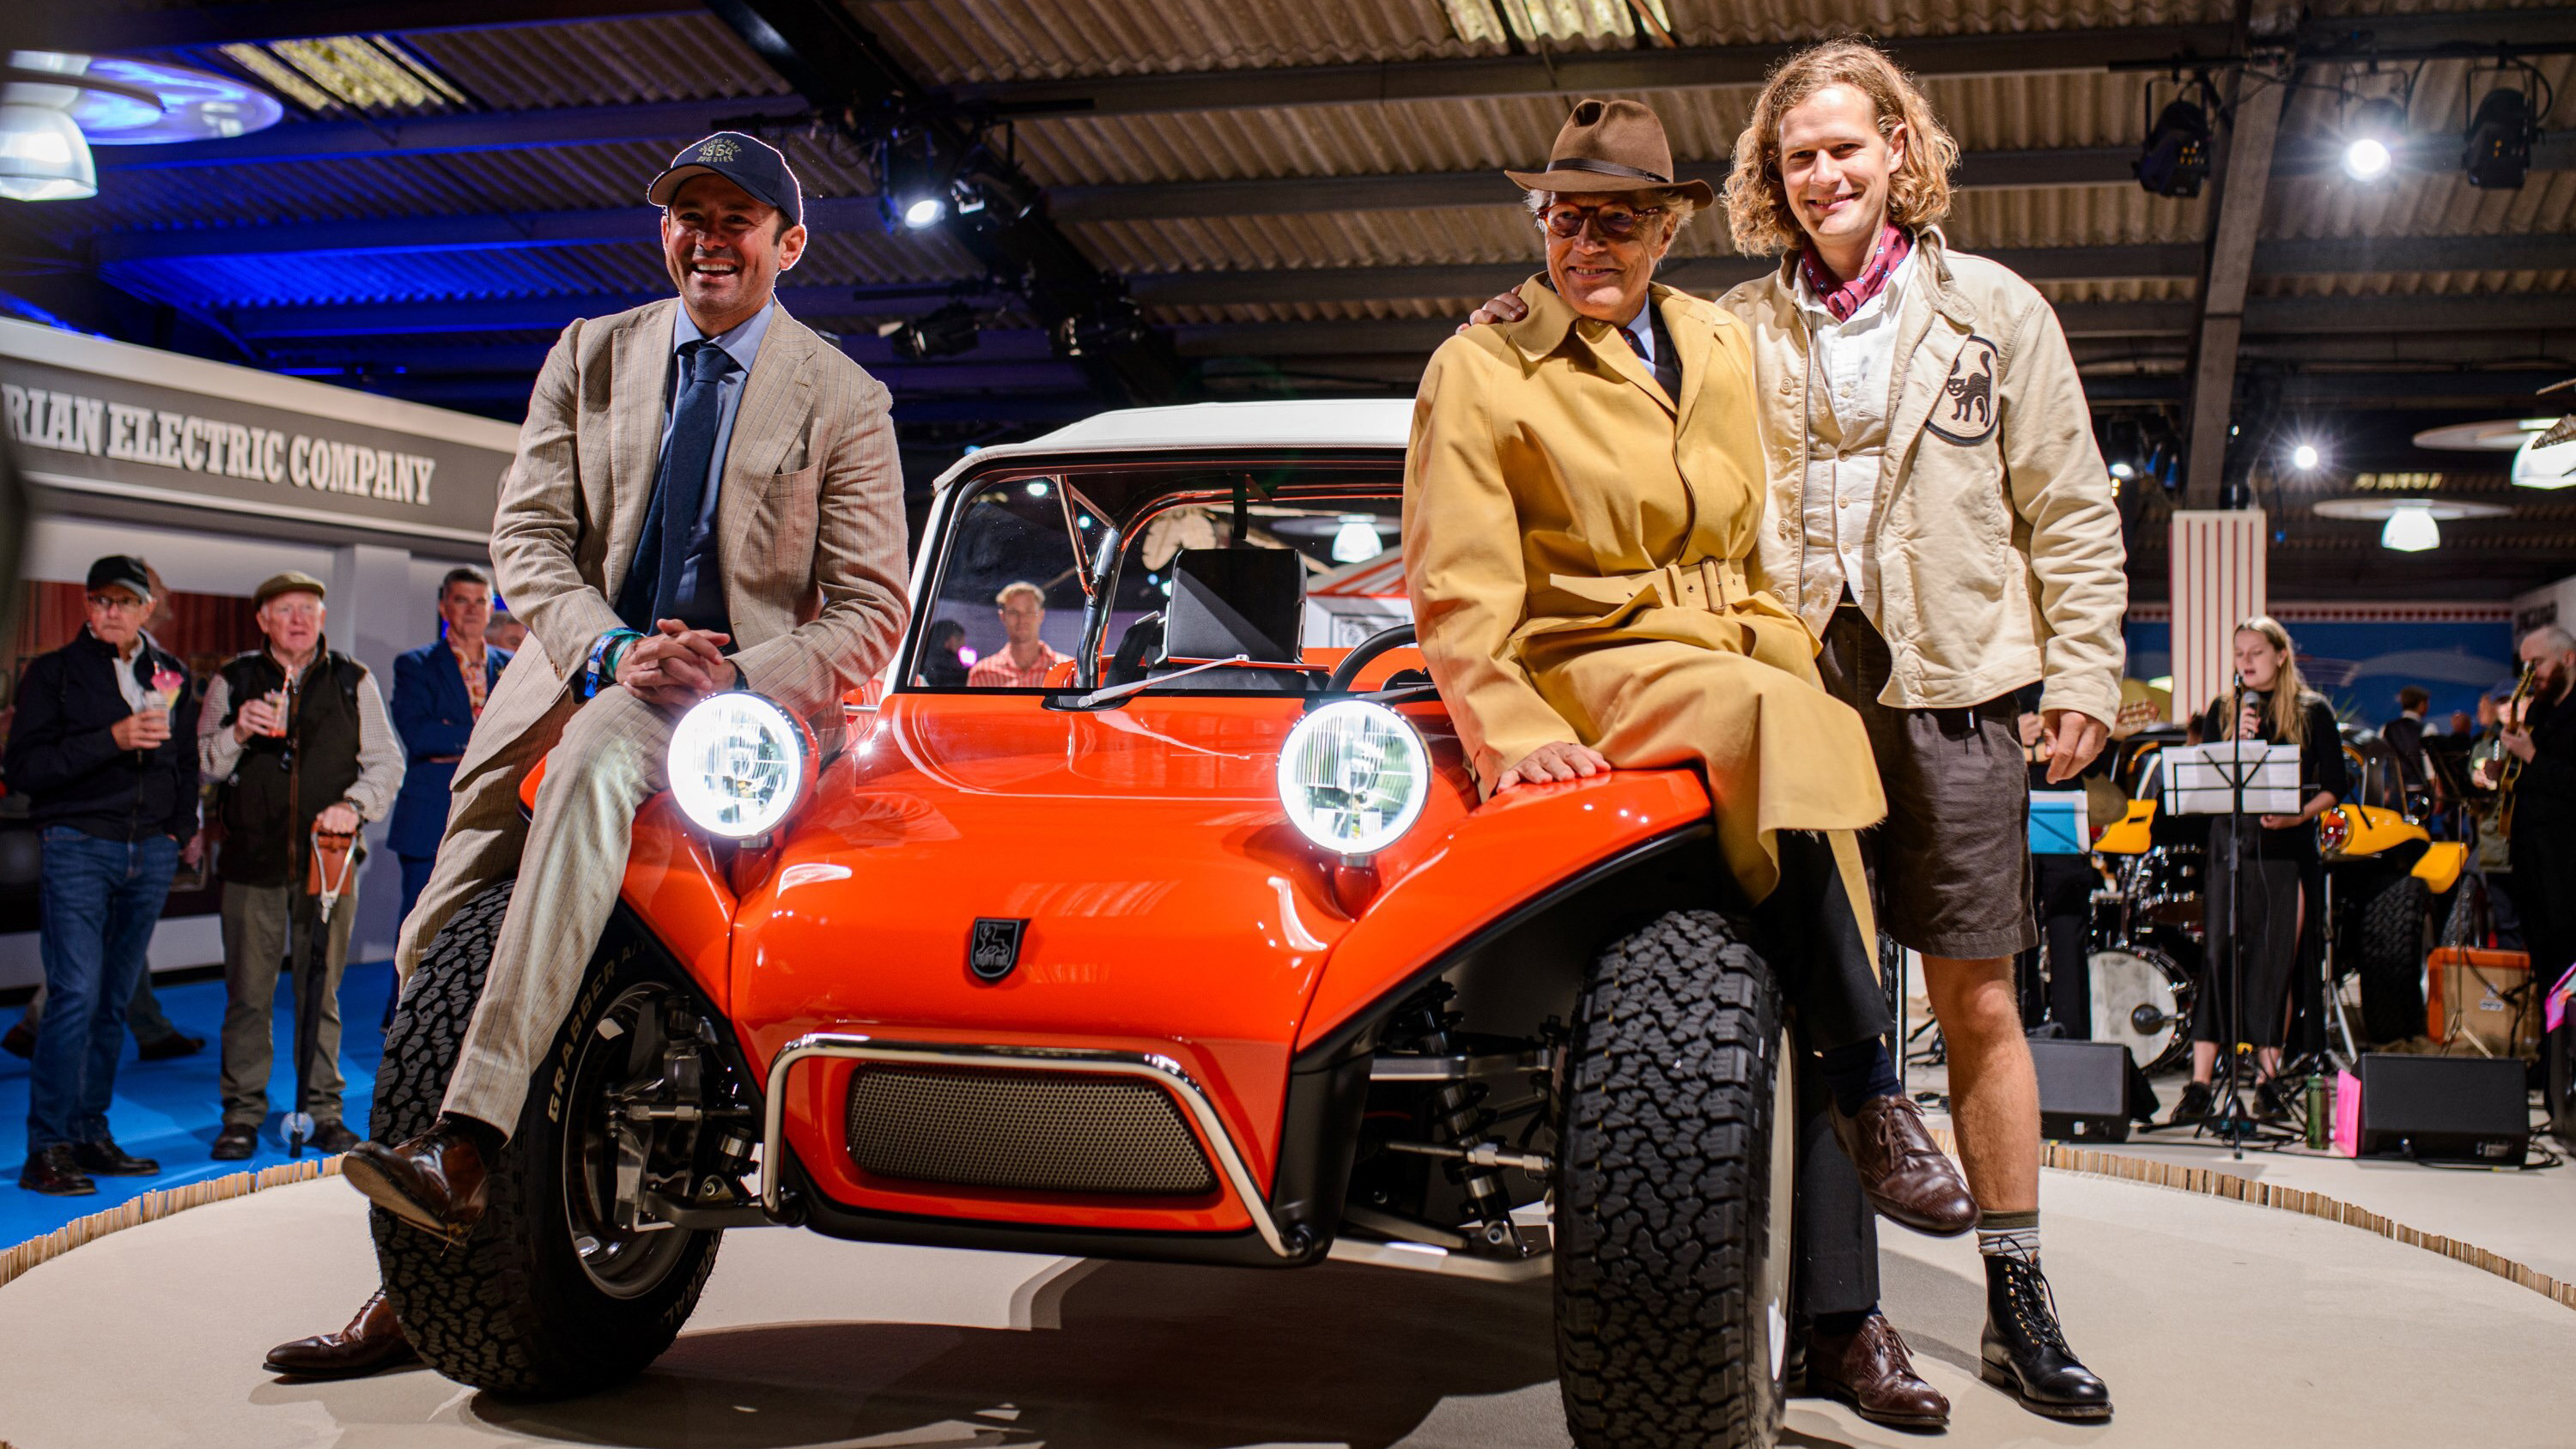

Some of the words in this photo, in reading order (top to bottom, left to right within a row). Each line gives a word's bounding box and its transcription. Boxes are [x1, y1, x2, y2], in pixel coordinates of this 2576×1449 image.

[702, 143, 734, 157] 1964
[1, 383, 104, 457] RIAN
[106, 402, 287, 483] ELECTRIC
[289, 434, 437, 506] COMPANY
[548, 957, 617, 1124] GRABBER
[664, 1232, 717, 1325] NERAL
